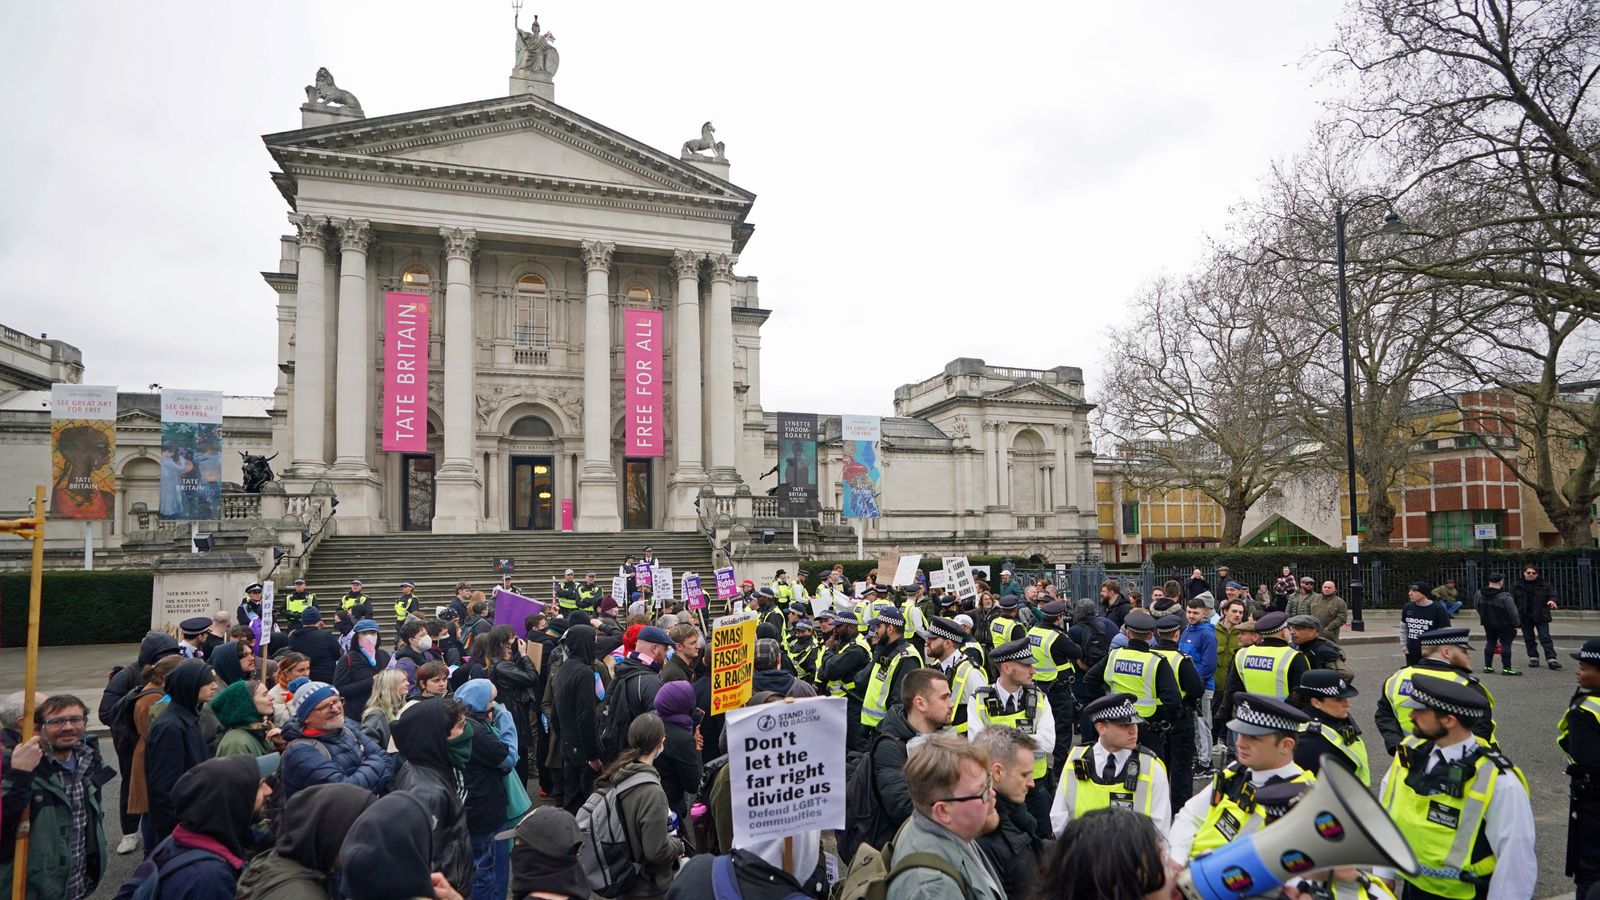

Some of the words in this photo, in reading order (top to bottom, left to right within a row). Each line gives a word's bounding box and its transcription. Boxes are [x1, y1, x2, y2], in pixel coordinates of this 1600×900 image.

[636, 319, 652, 351] ALL
[397, 303, 417, 385] BRITAIN
[636, 359, 652, 395] FOR
[395, 394, 415, 441] TATE
[636, 404, 653, 447] FREE
[952, 560, 965, 571] LEAVE
[716, 572, 730, 580] Trans
[959, 578, 969, 587] KIDS
[686, 580, 697, 588] Trans
[717, 579, 735, 589] Rights
[687, 588, 702, 596] Rights
[718, 588, 731, 596] Now
[690, 597, 700, 606] Now
[1405, 617, 1433, 626] GROOM
[1115, 660, 1142, 674] POLICE
[1245, 656, 1273, 670] POLICE
[713, 673, 722, 690] &
[778, 709, 803, 720] STAND
[805, 708, 817, 716] UP
[779, 720, 789, 728] TO
[790, 715, 820, 726] RACISM
[744, 731, 797, 753] Don't
[745, 754, 772, 771] let
[777, 750, 808, 767] the
[746, 774, 775, 789] far
[780, 762, 825, 785] right
[747, 786, 805, 808] divide
[810, 781, 831, 796] us
[748, 804, 790, 820] Defend
[792, 796, 829, 812] LGBT+
[748, 809, 823, 830] communities
